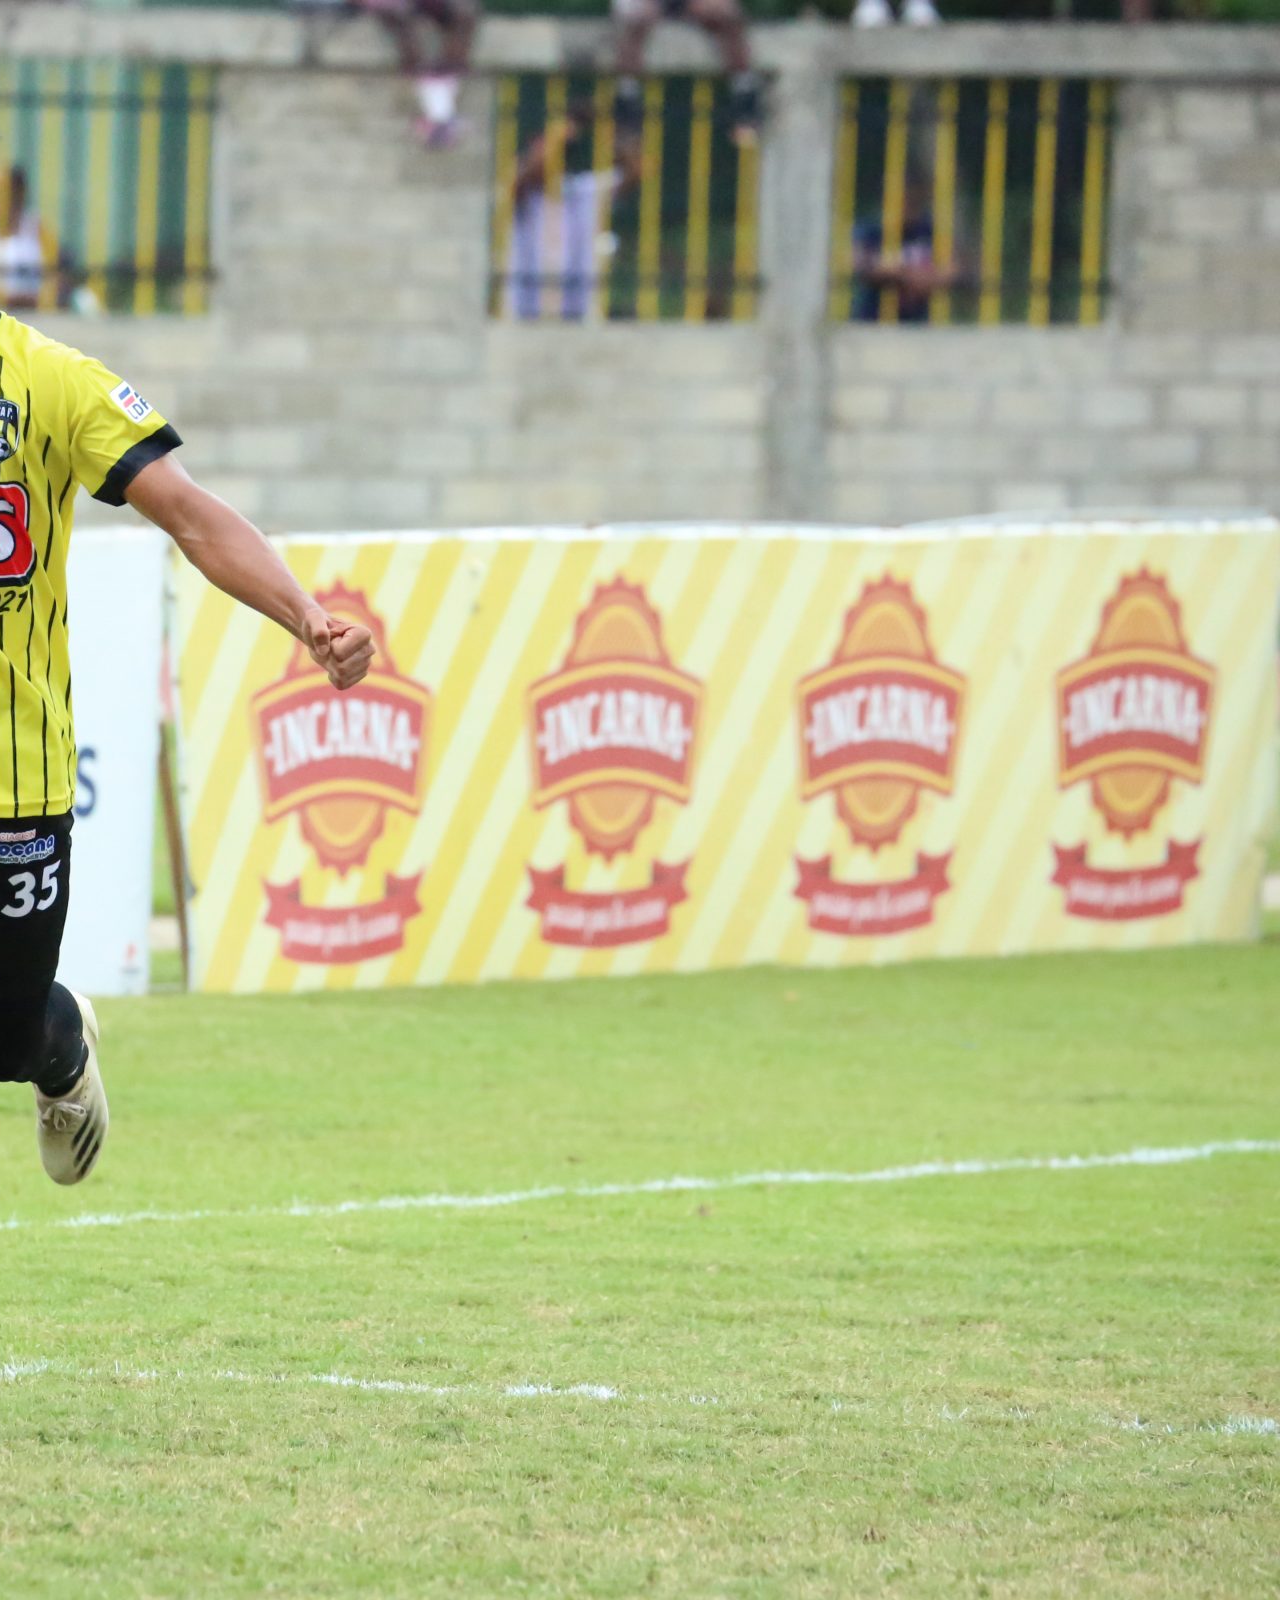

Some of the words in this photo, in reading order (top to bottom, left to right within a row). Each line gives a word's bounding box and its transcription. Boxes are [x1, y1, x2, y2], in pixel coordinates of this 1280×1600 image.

[267, 698, 418, 777] INCARNA
[542, 688, 689, 765] INCARNA
[809, 683, 952, 758] INCARNA
[1066, 674, 1202, 749] INCARNA
[1, 859, 61, 918] 35
